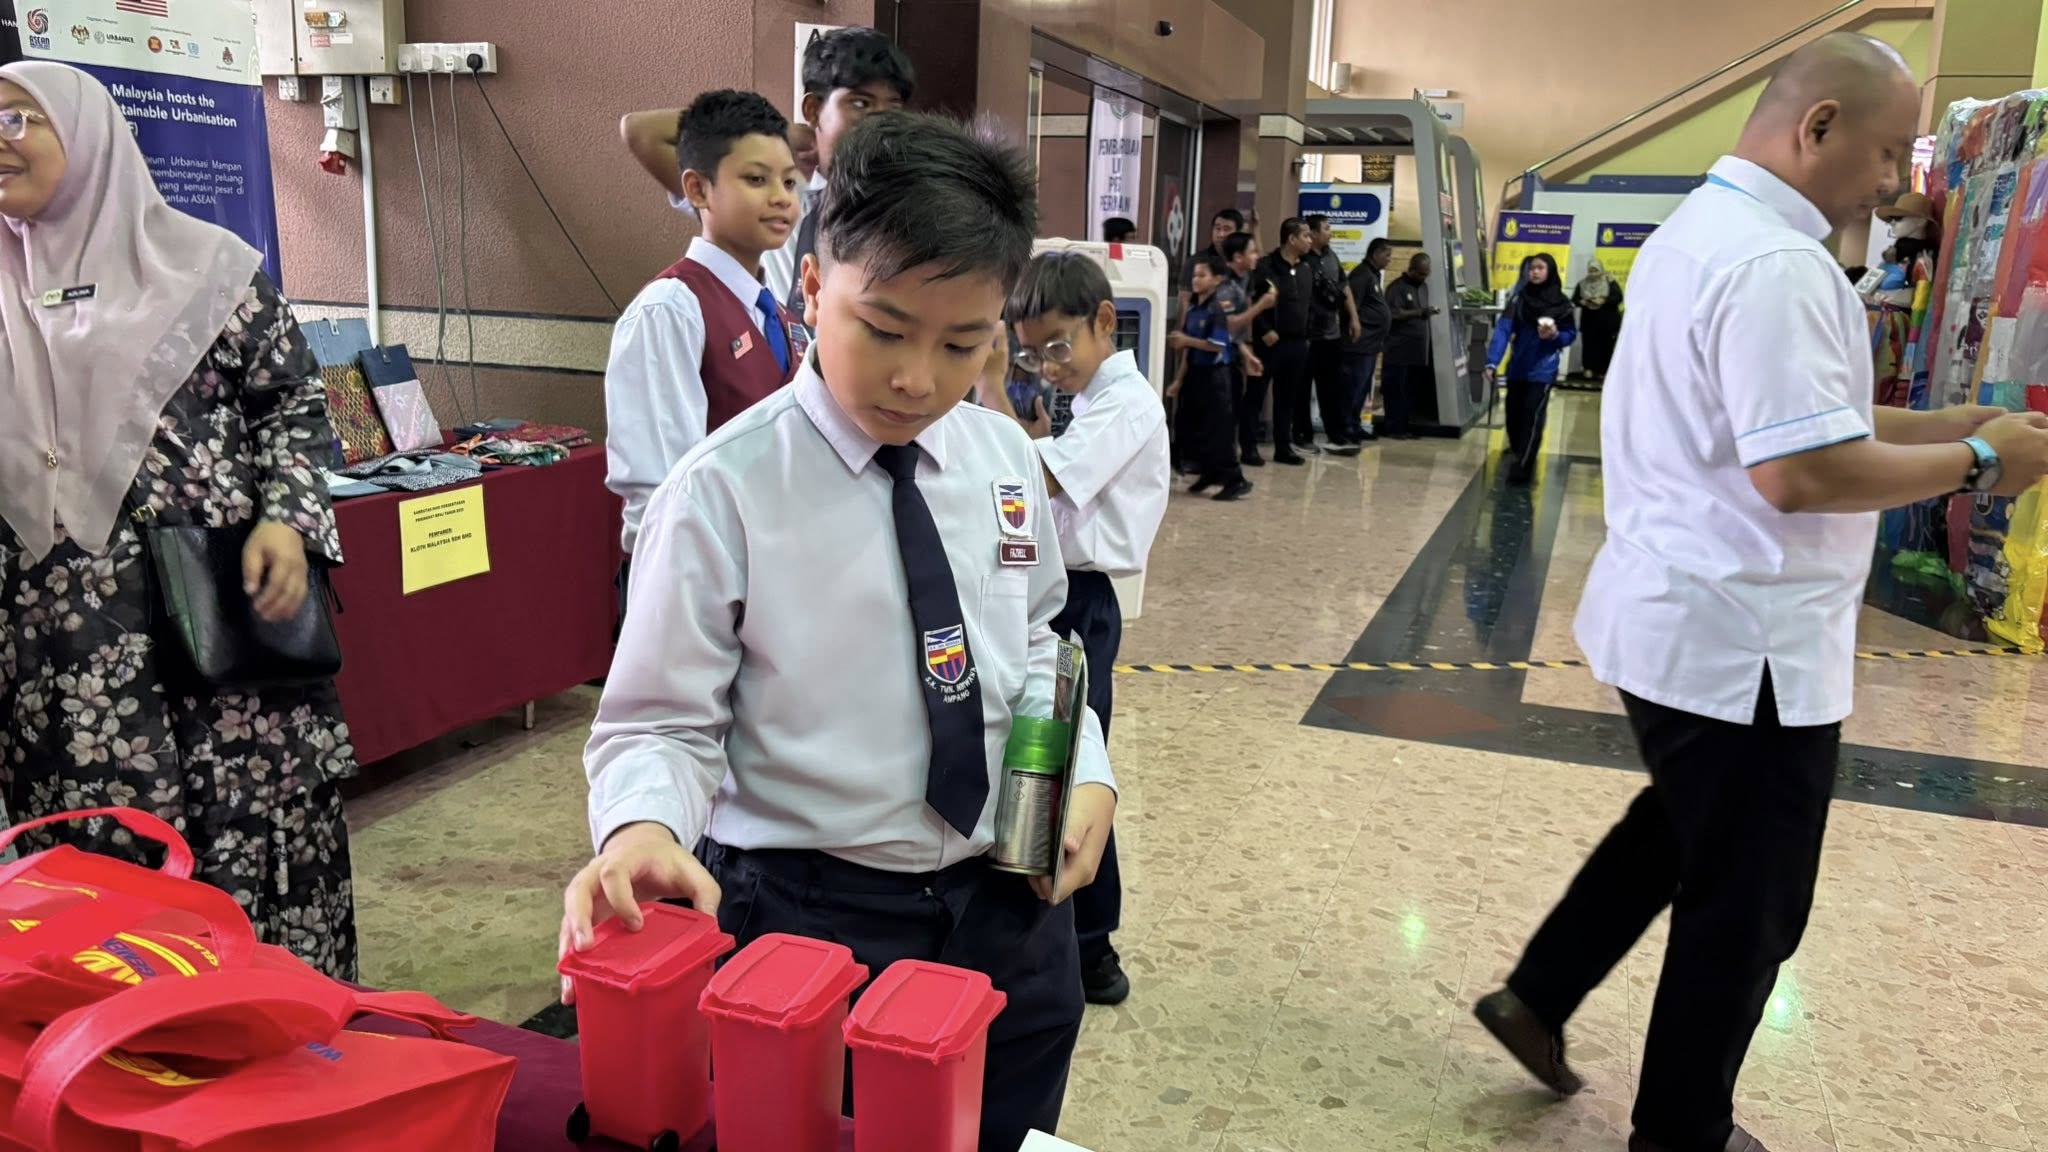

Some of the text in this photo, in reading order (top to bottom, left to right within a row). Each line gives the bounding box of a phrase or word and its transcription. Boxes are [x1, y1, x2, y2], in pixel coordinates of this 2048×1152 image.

[112, 83, 215, 108] Malaysia hosts the
[121, 103, 237, 127] tainable Urbanisation
[427, 538, 450, 548] MALAYSIA
